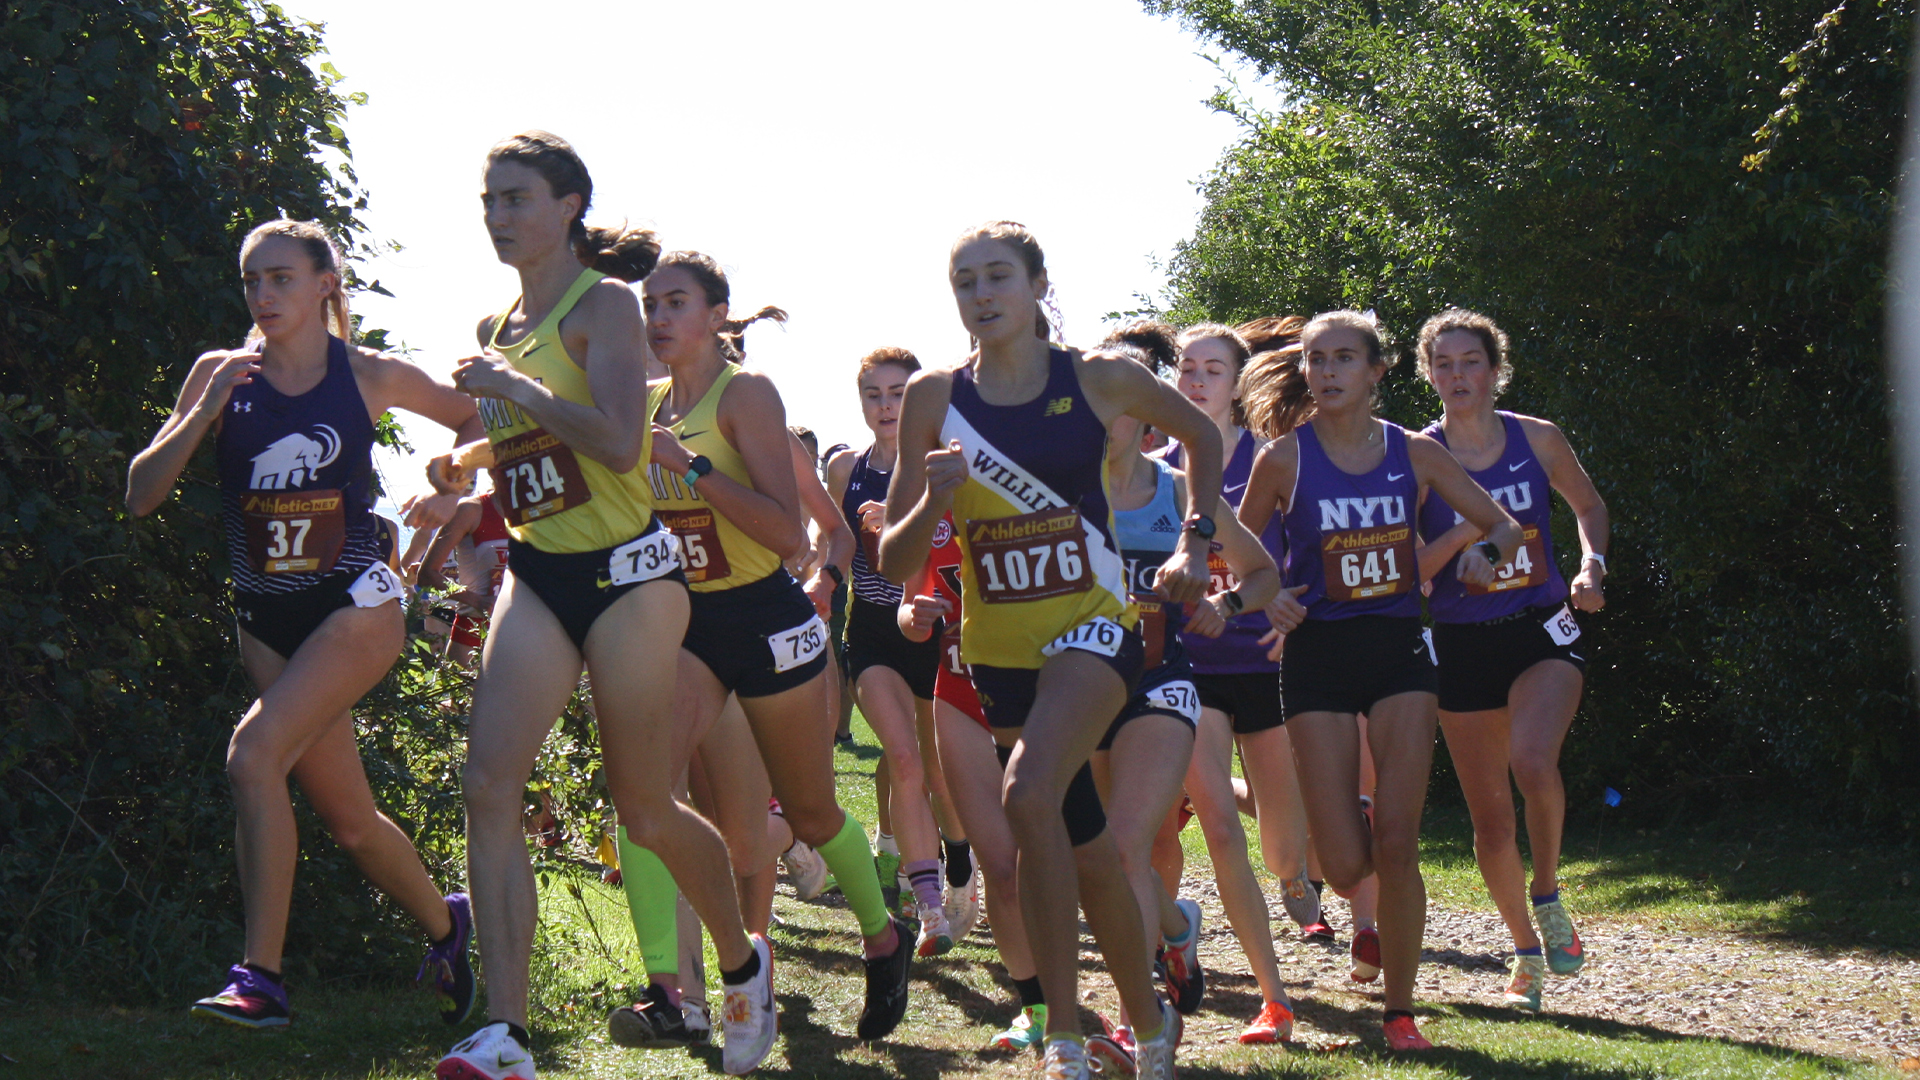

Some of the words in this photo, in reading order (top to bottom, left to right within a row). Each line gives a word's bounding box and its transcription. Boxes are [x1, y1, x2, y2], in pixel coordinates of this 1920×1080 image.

[506, 455, 564, 509] 734
[244, 496, 311, 514] Athletic
[313, 500, 337, 510] NET
[1318, 495, 1406, 531] NYU
[267, 518, 312, 558] 37
[971, 521, 1048, 542] Athletic
[1050, 517, 1076, 530] NET
[1324, 532, 1388, 550] Athletic
[1389, 530, 1408, 541] NET
[626, 537, 671, 575] 734
[981, 540, 1083, 591] 1076
[1341, 547, 1401, 587] 641
[368, 567, 396, 594] 37
[1139, 602, 1159, 611] NET
[786, 624, 821, 660] 735
[1051, 621, 1115, 646] 076
[1161, 687, 1197, 714] 574
